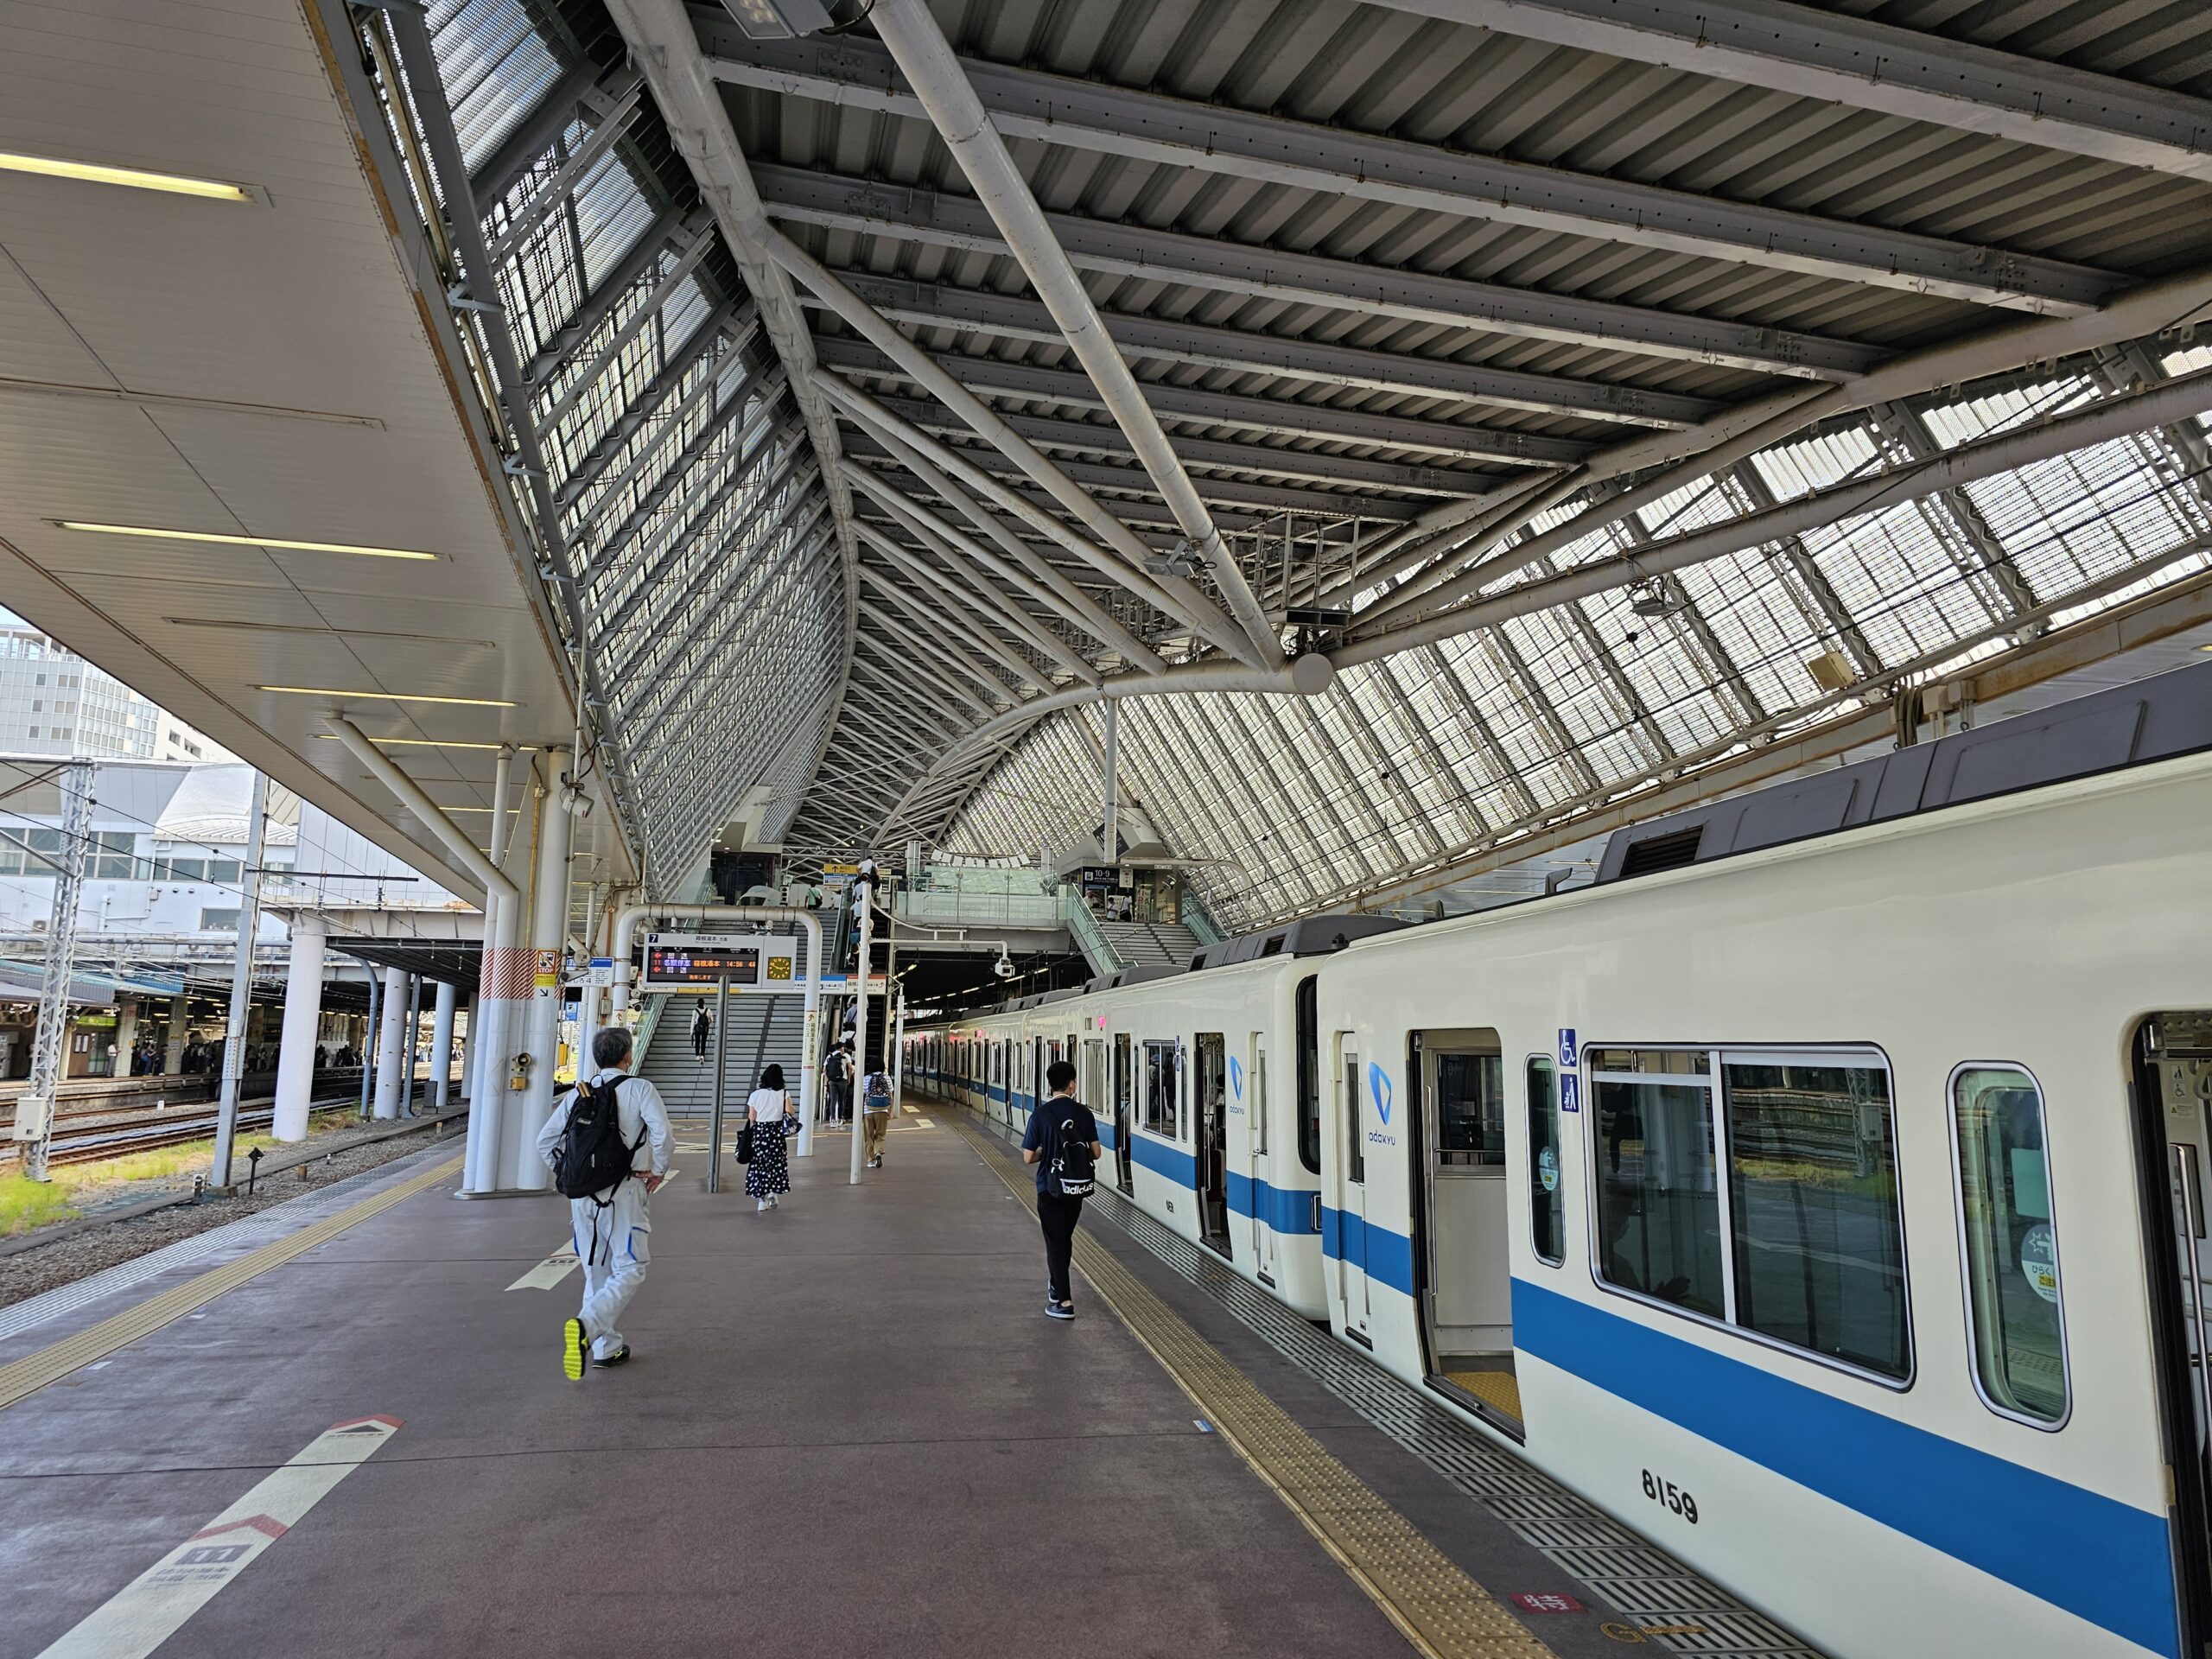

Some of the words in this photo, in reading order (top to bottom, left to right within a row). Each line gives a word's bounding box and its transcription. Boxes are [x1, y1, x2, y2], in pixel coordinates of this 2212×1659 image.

[1230, 1104, 1245, 1116] odakyu
[1368, 1128, 1396, 1147] odakyu
[1642, 1468, 1699, 1525] 8159
